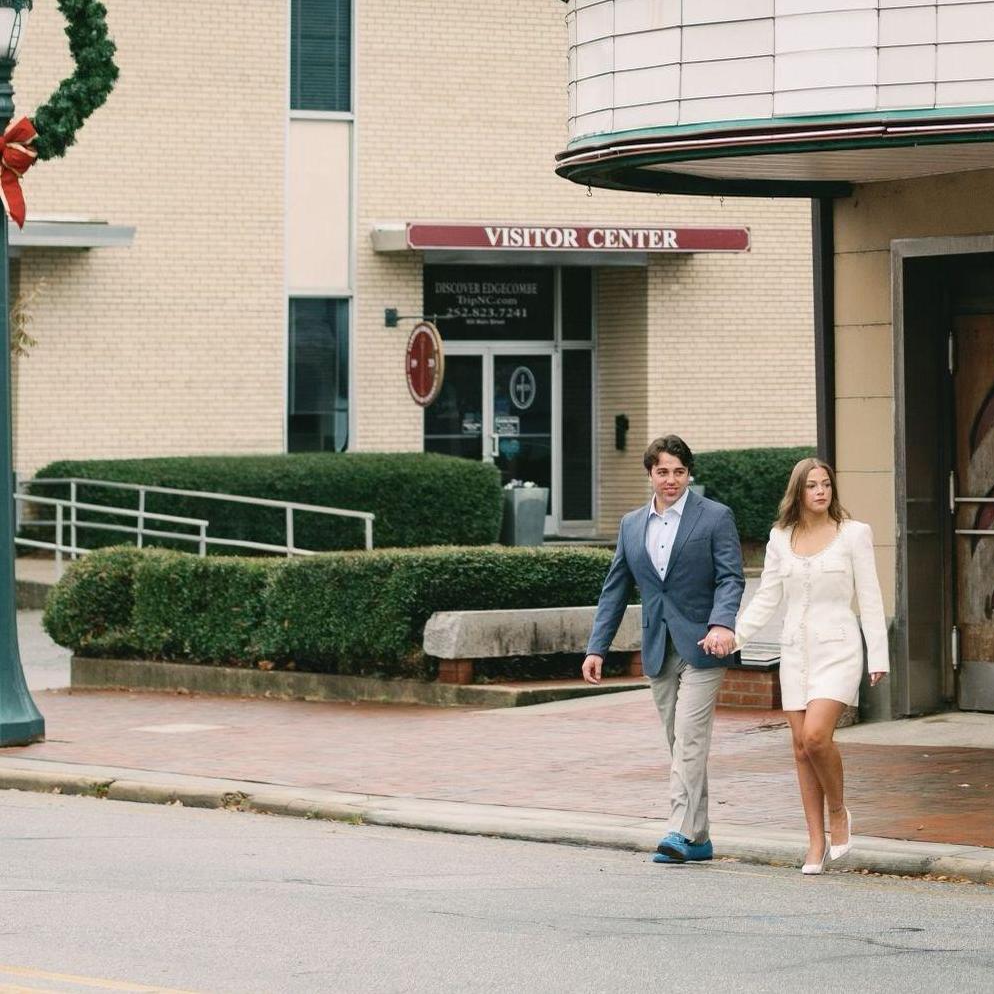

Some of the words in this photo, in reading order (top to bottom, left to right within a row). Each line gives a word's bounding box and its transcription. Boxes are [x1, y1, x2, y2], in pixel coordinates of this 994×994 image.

[484, 227, 579, 248] VISITOR
[587, 228, 679, 249] CENTER
[435, 282, 480, 294] DISCOVER
[482, 282, 538, 295] EDGECOMBE
